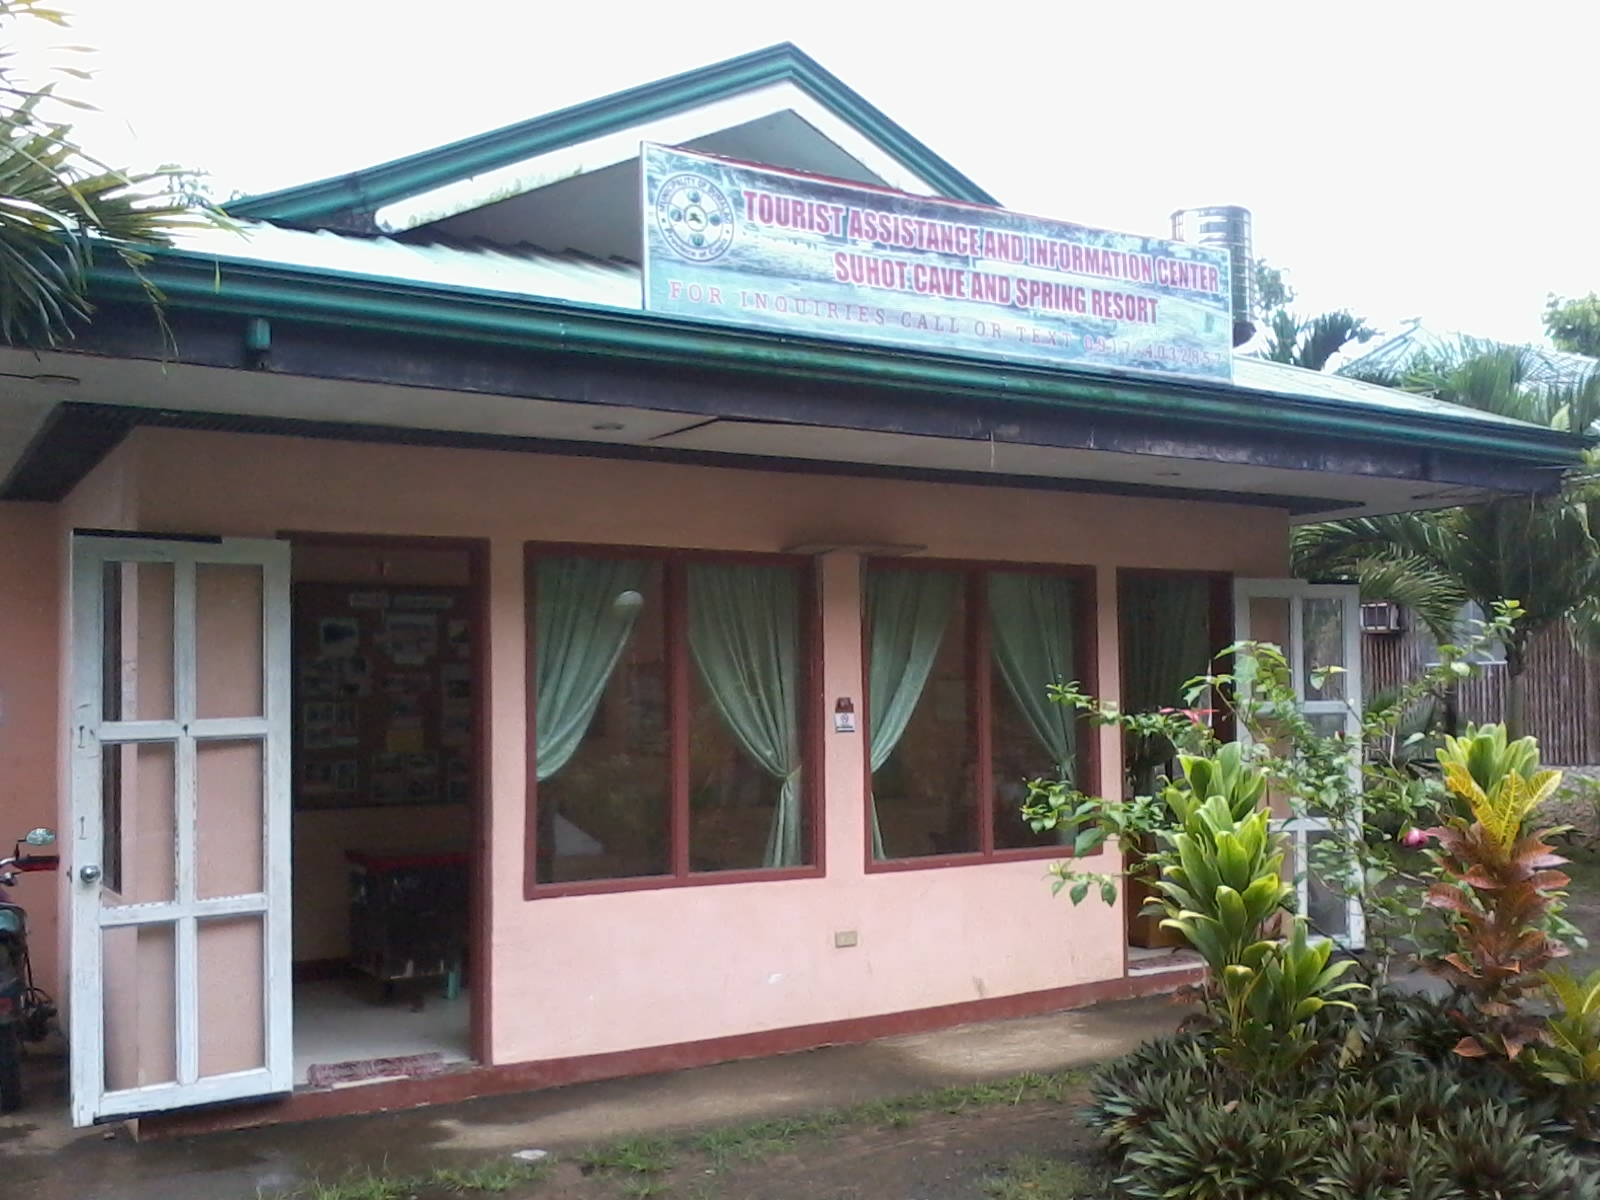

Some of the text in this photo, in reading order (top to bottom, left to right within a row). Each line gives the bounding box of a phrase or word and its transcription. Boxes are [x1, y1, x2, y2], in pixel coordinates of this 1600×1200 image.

[743, 190, 1219, 292] TOURIST ASSISTANCE AND INFORMATION CENTER
[670, 281, 722, 304] FOR
[741, 291, 885, 325] INQUIRIES
[901, 312, 960, 333] CALL
[974, 321, 1002, 338] OR
[1016, 327, 1072, 348] TEXT
[834, 252, 1158, 324] SUHOT CAVE AND SPRING RESORT
